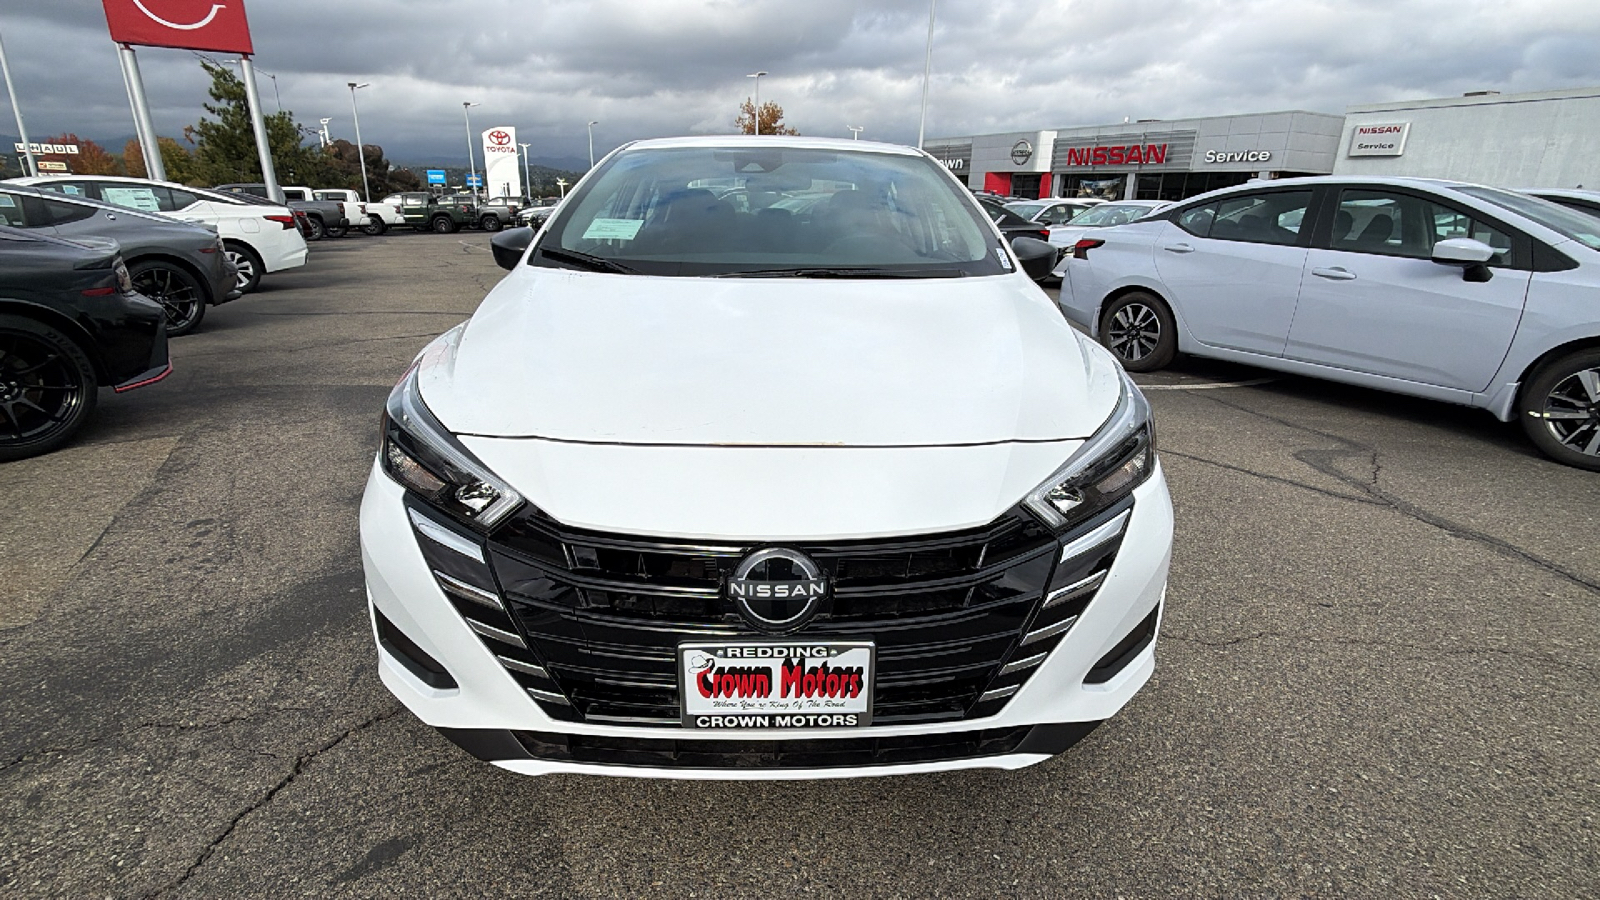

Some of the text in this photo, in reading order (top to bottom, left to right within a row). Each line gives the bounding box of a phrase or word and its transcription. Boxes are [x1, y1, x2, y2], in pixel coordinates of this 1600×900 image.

[1359, 126, 1402, 135] NISSAN
[1357, 142, 1395, 150] Service
[1067, 144, 1168, 166] NISSAN
[1204, 149, 1271, 164] Service
[730, 582, 824, 598] NISSAN
[726, 647, 828, 658] REDDING
[696, 659, 864, 699] Crown Motors
[712, 700, 846, 709] Where You're King Of The Road
[696, 714, 858, 728] CROWN MOTORS
